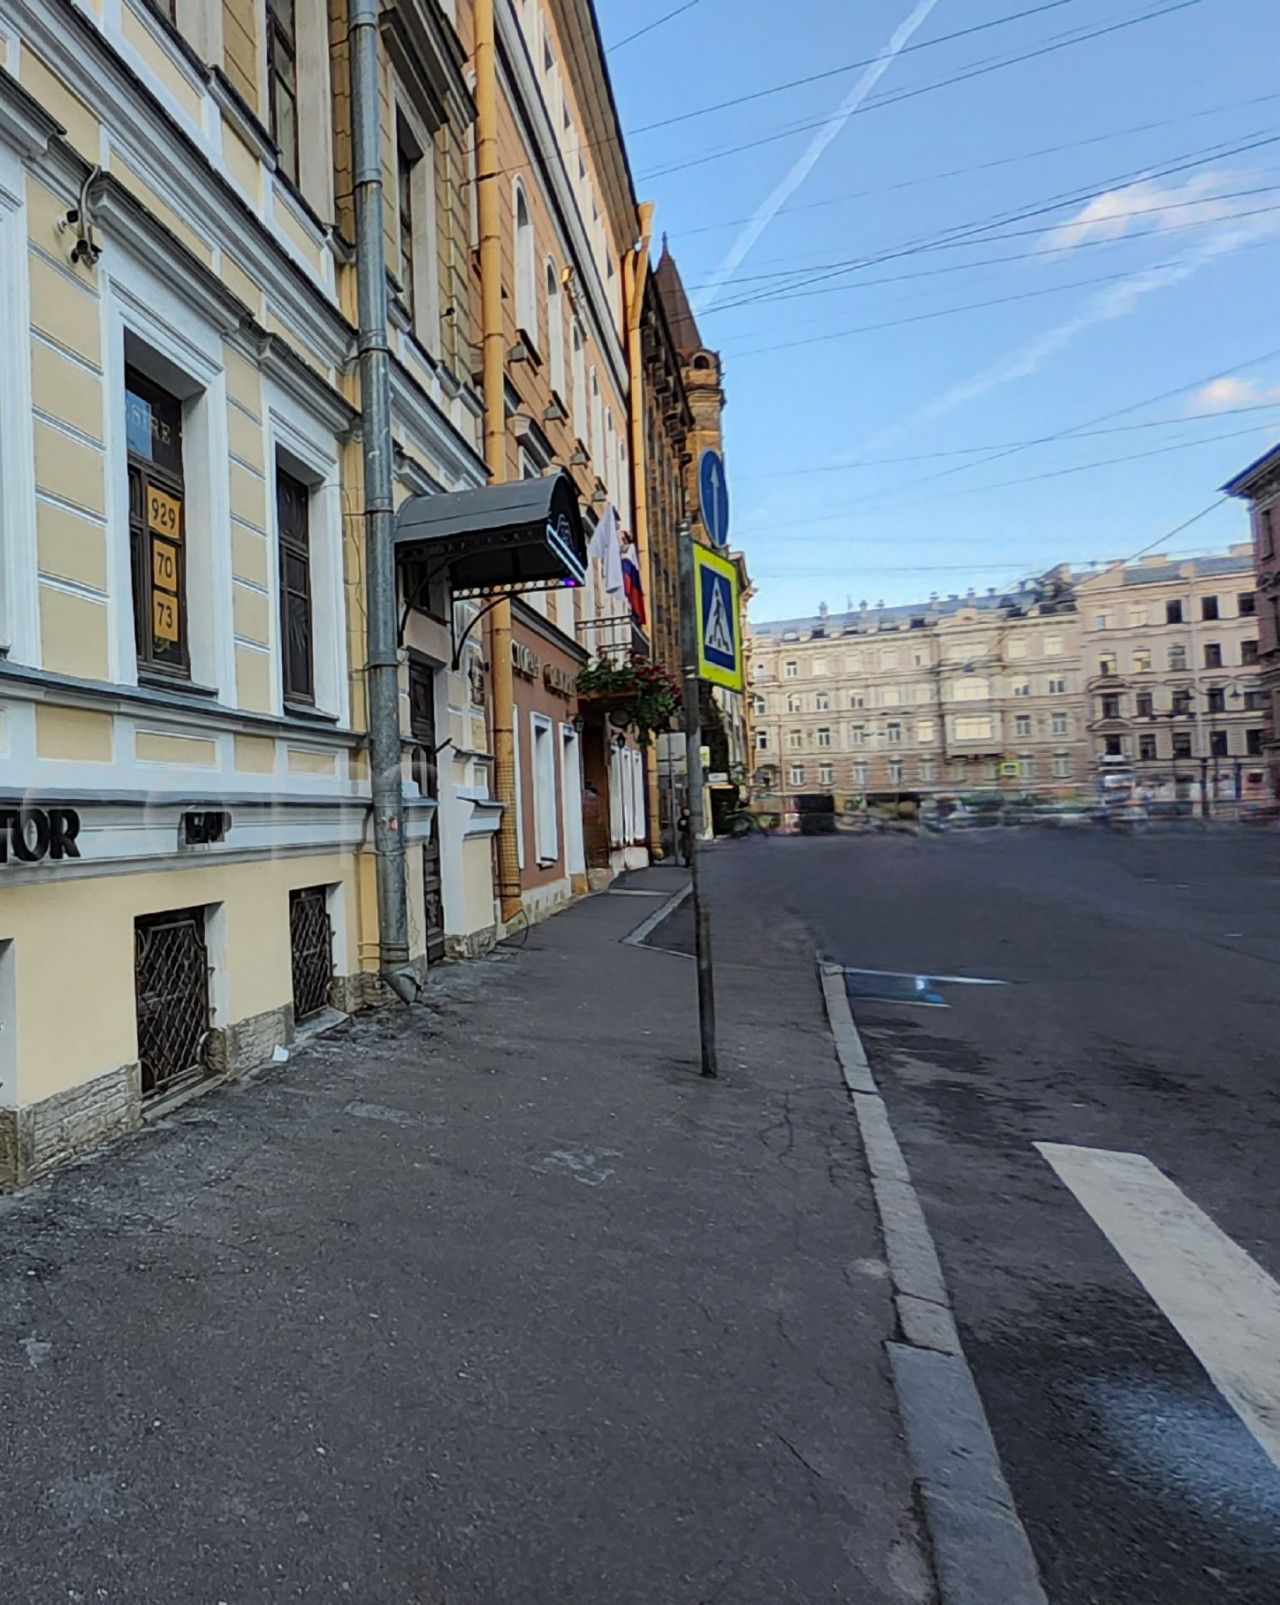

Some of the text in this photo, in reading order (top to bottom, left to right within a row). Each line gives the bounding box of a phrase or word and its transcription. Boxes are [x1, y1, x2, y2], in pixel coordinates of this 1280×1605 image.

[151, 497, 176, 530] 929
[157, 551, 173, 579] 70
[157, 602, 173, 629] 73
